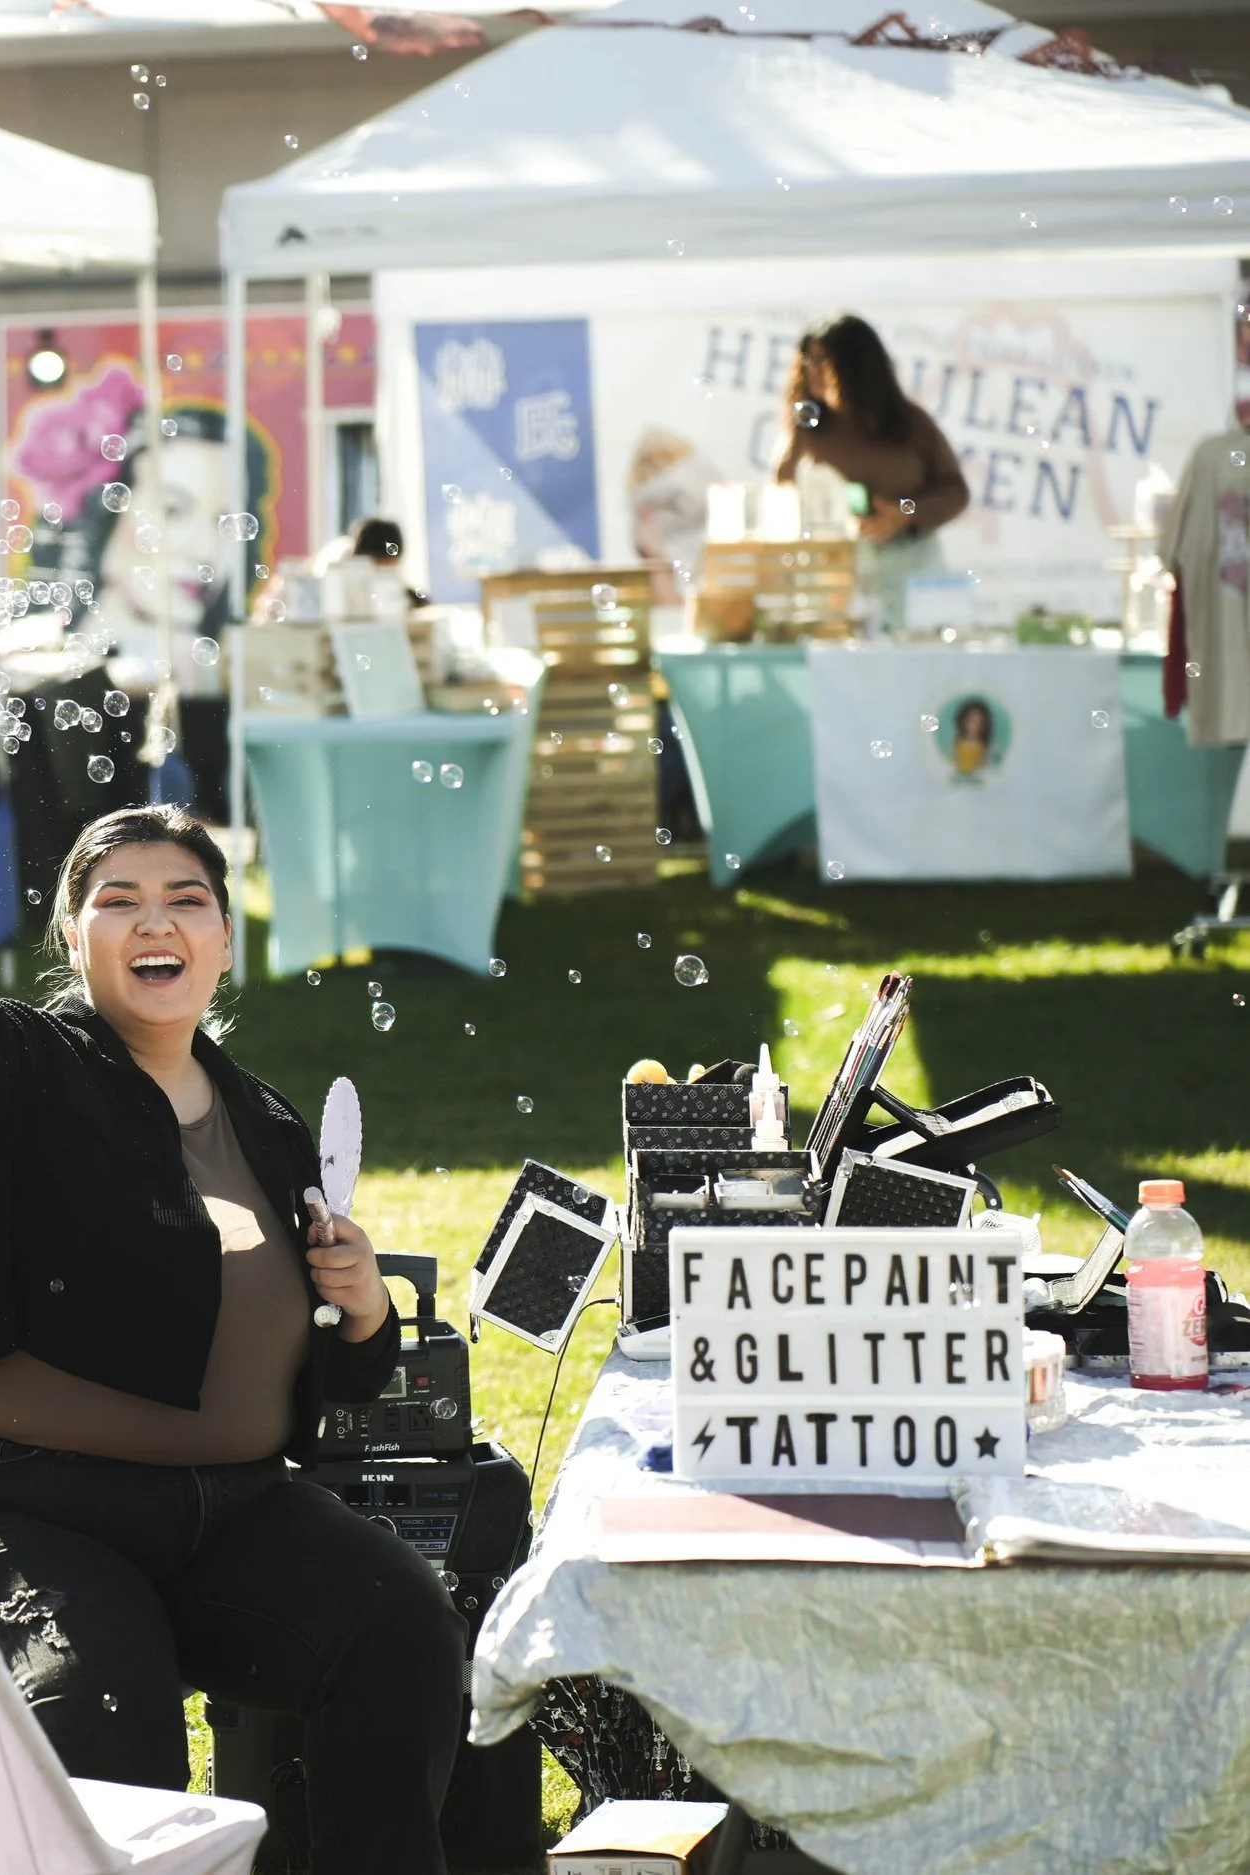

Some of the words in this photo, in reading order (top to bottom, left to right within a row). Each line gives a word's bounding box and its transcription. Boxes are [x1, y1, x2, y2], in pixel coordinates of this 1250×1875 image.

[701, 323, 1161, 458] HEULEAN
[683, 1252, 1017, 1310] FACEPAINT
[364, 1443, 400, 1452] FashFish
[725, 1413, 958, 1467] TATTOO
